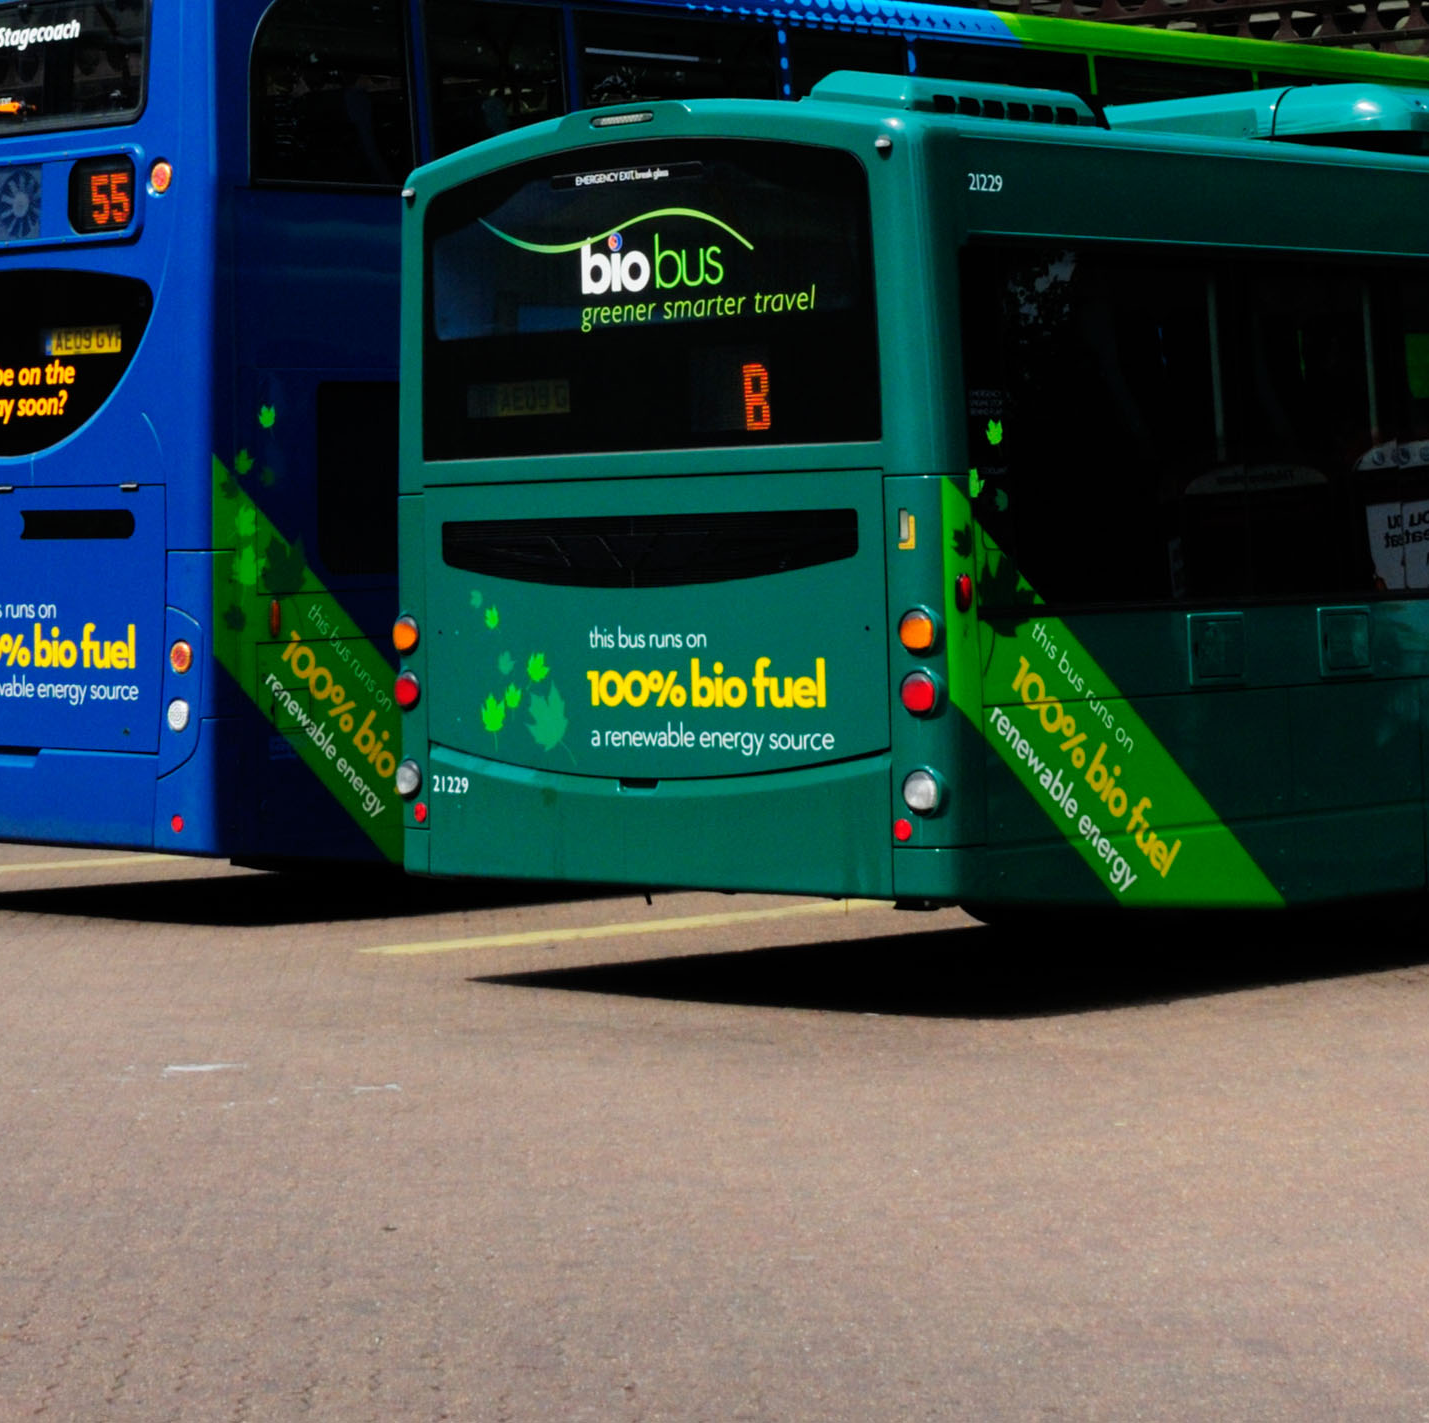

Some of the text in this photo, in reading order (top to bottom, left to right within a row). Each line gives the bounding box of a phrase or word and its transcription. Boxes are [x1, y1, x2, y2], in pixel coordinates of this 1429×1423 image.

[90, 172, 130, 224] 55
[968, 173, 1003, 192] 21229
[581, 232, 724, 295] bio bus
[581, 284, 815, 332] greener smarter travel
[55, 328, 92, 352] AE09
[18, 366, 41, 386] on
[45, 359, 76, 385] the
[17, 389, 68, 416] soon?
[741, 363, 771, 432] B
[5, 603, 35, 618] runs
[38, 603, 56, 619] on
[34, 623, 78, 668] bio
[81, 622, 136, 669] fuel
[307, 604, 393, 712] this bus runs on
[589, 625, 707, 649] this bus runs on
[37, 682, 87, 706] energy
[90, 684, 139, 701] source
[281, 630, 356, 733] 100%
[353, 709, 396, 778] bio
[586, 656, 827, 709] 100% bio fuel
[1030, 622, 1135, 754] this bus runs on
[265, 673, 337, 760] renewable
[336, 757, 386, 818] energy
[591, 721, 835, 756] a renewable energy source
[433, 775, 469, 793] 21229
[1011, 656, 1182, 879] 100% bio fuel
[989, 706, 1138, 893] renewable energy
